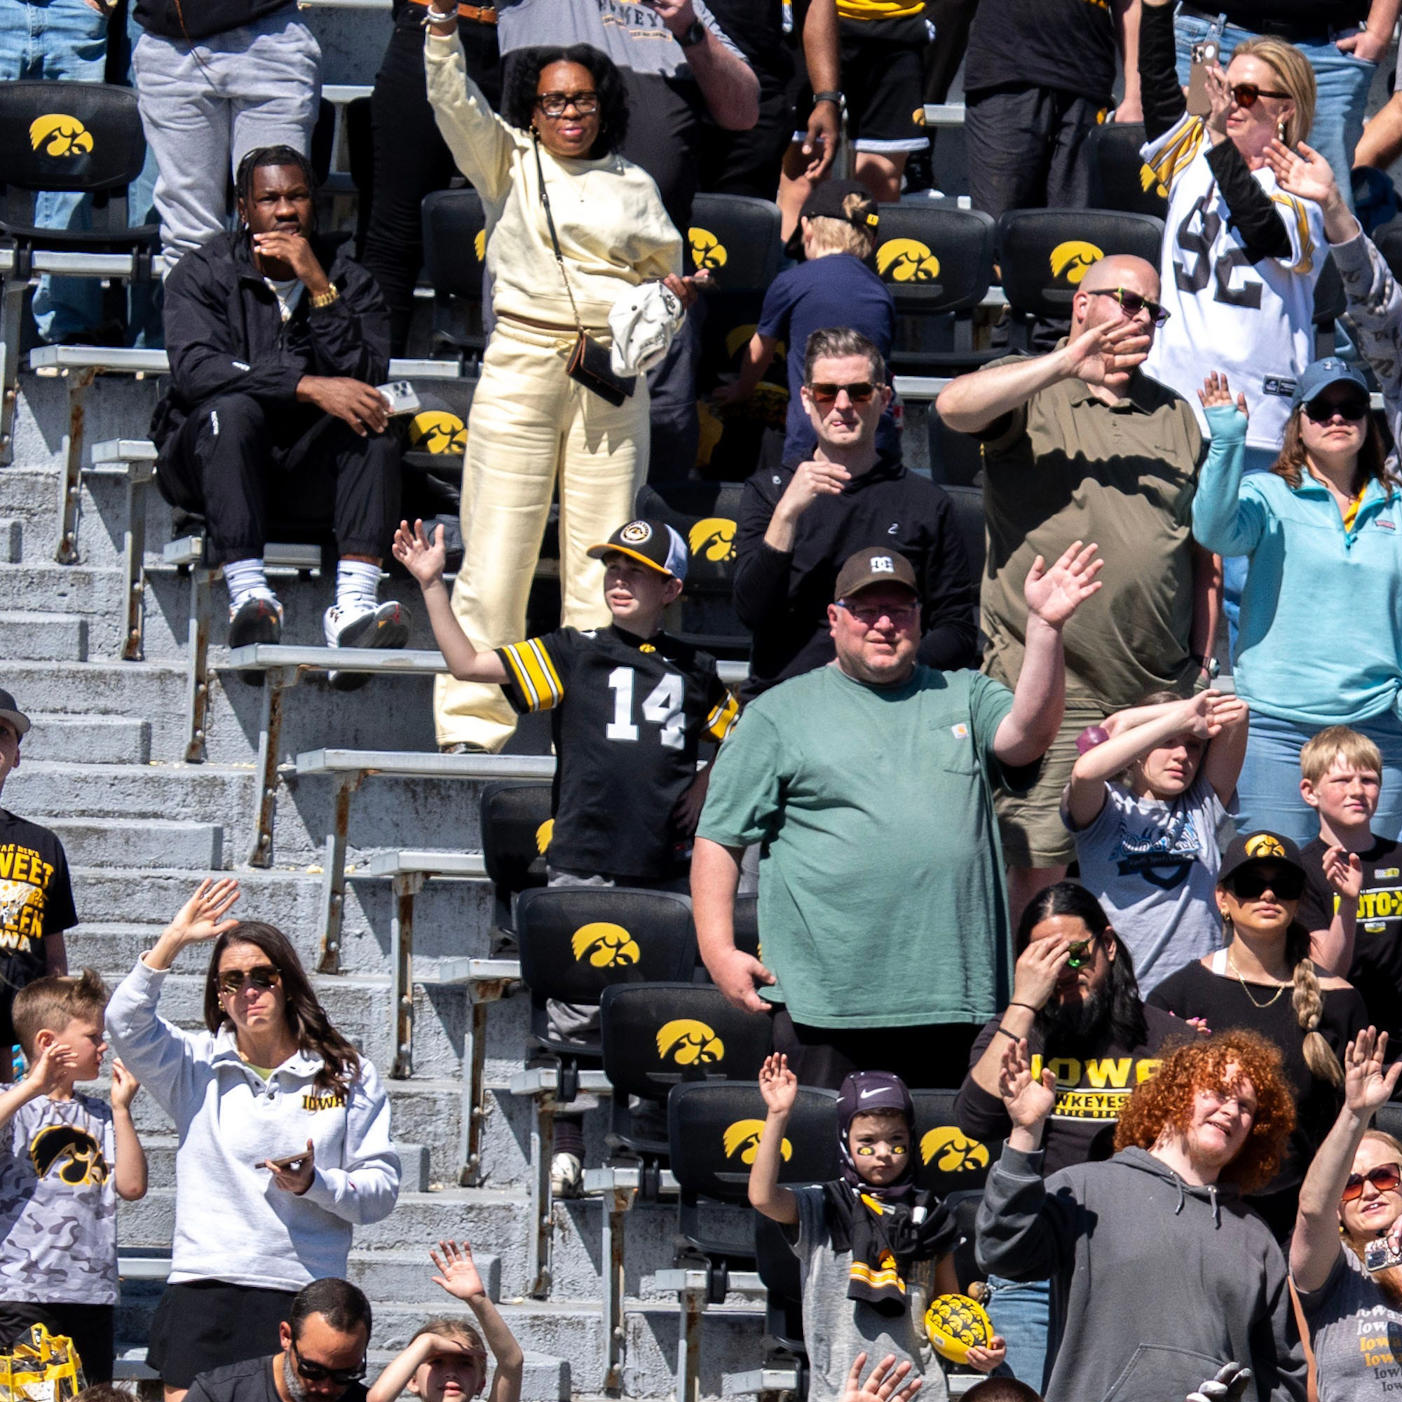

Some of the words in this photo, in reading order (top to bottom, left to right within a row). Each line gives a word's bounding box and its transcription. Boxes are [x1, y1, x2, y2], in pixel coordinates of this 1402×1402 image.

[606, 667, 687, 751] 14
[302, 1094, 346, 1111] IOWA
[1359, 1337, 1402, 1352] Iowa
